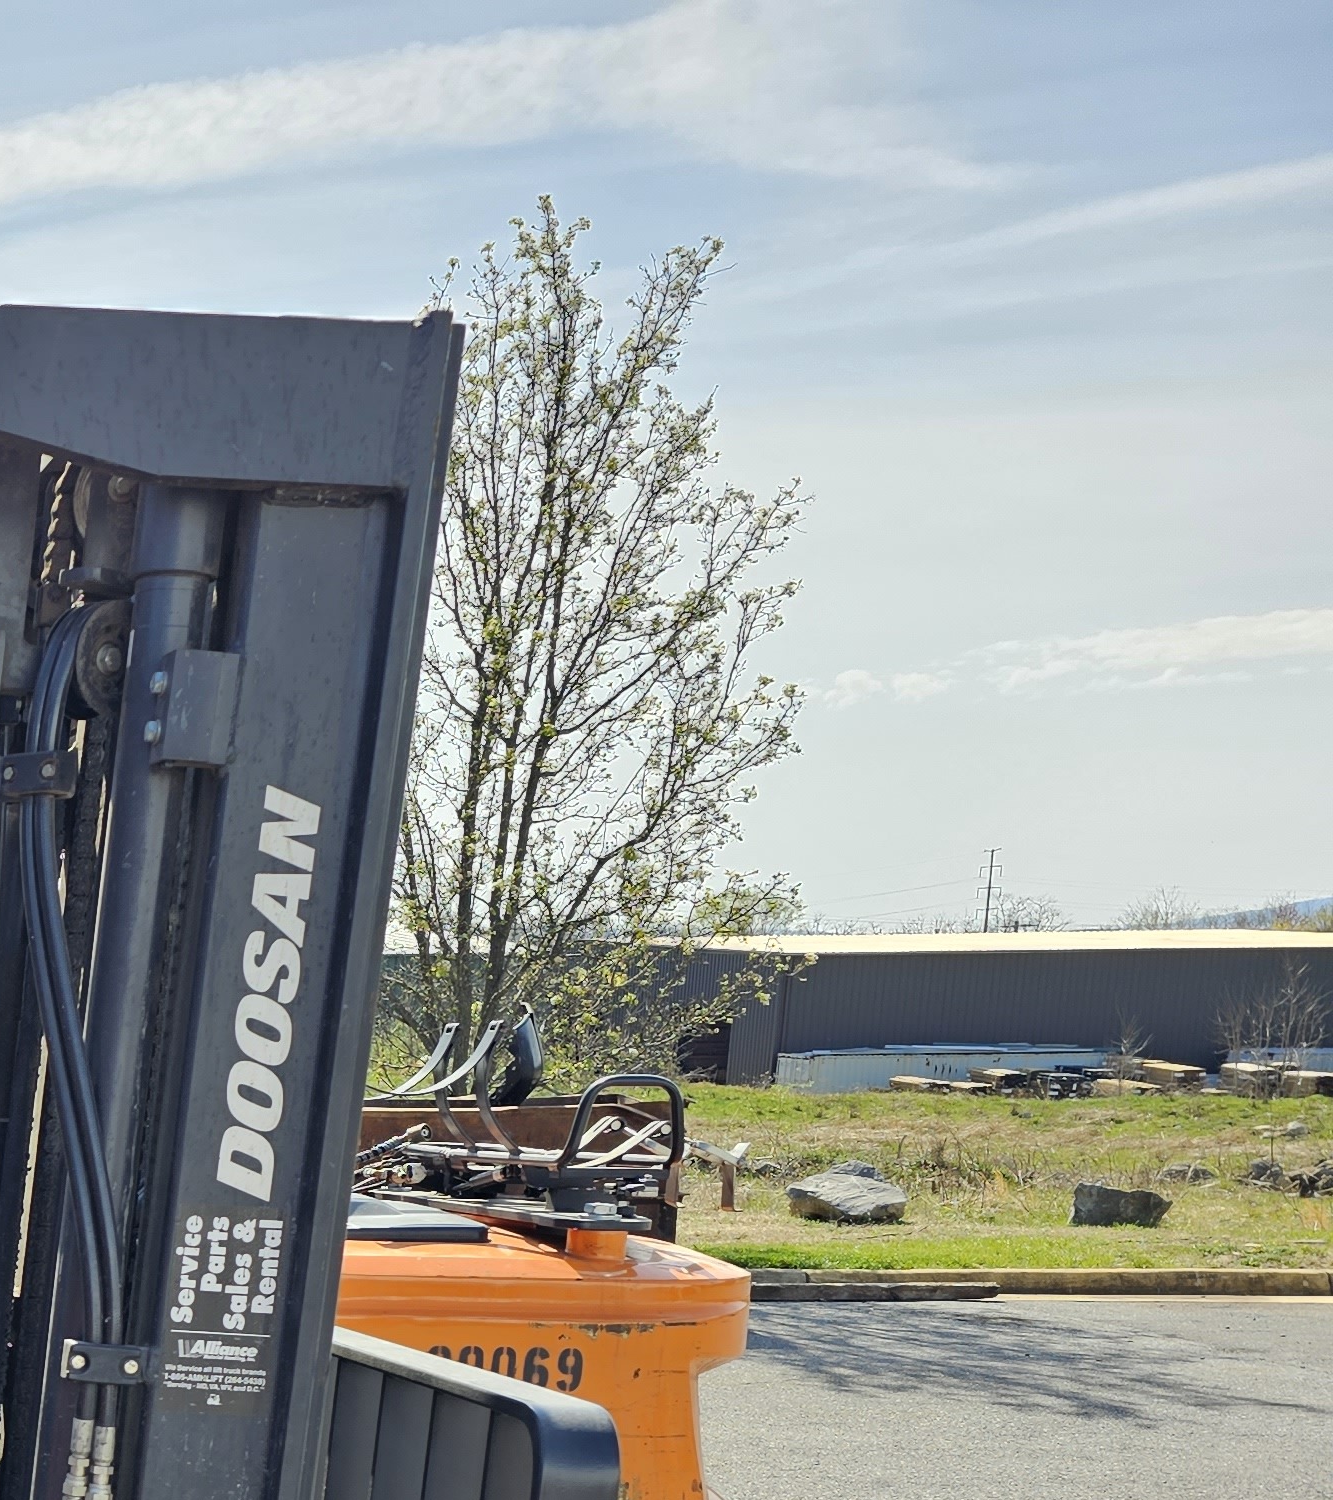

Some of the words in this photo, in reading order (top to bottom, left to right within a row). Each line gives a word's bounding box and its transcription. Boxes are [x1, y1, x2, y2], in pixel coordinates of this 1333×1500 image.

[216, 784, 322, 1202] DOOSAN
[170, 1214, 204, 1324] Service
[199, 1216, 230, 1293] Parts
[232, 1218, 257, 1243] &
[250, 1219, 284, 1315] Rental
[222, 1253, 253, 1331] Sales
[190, 1339, 259, 1357] Alliance
